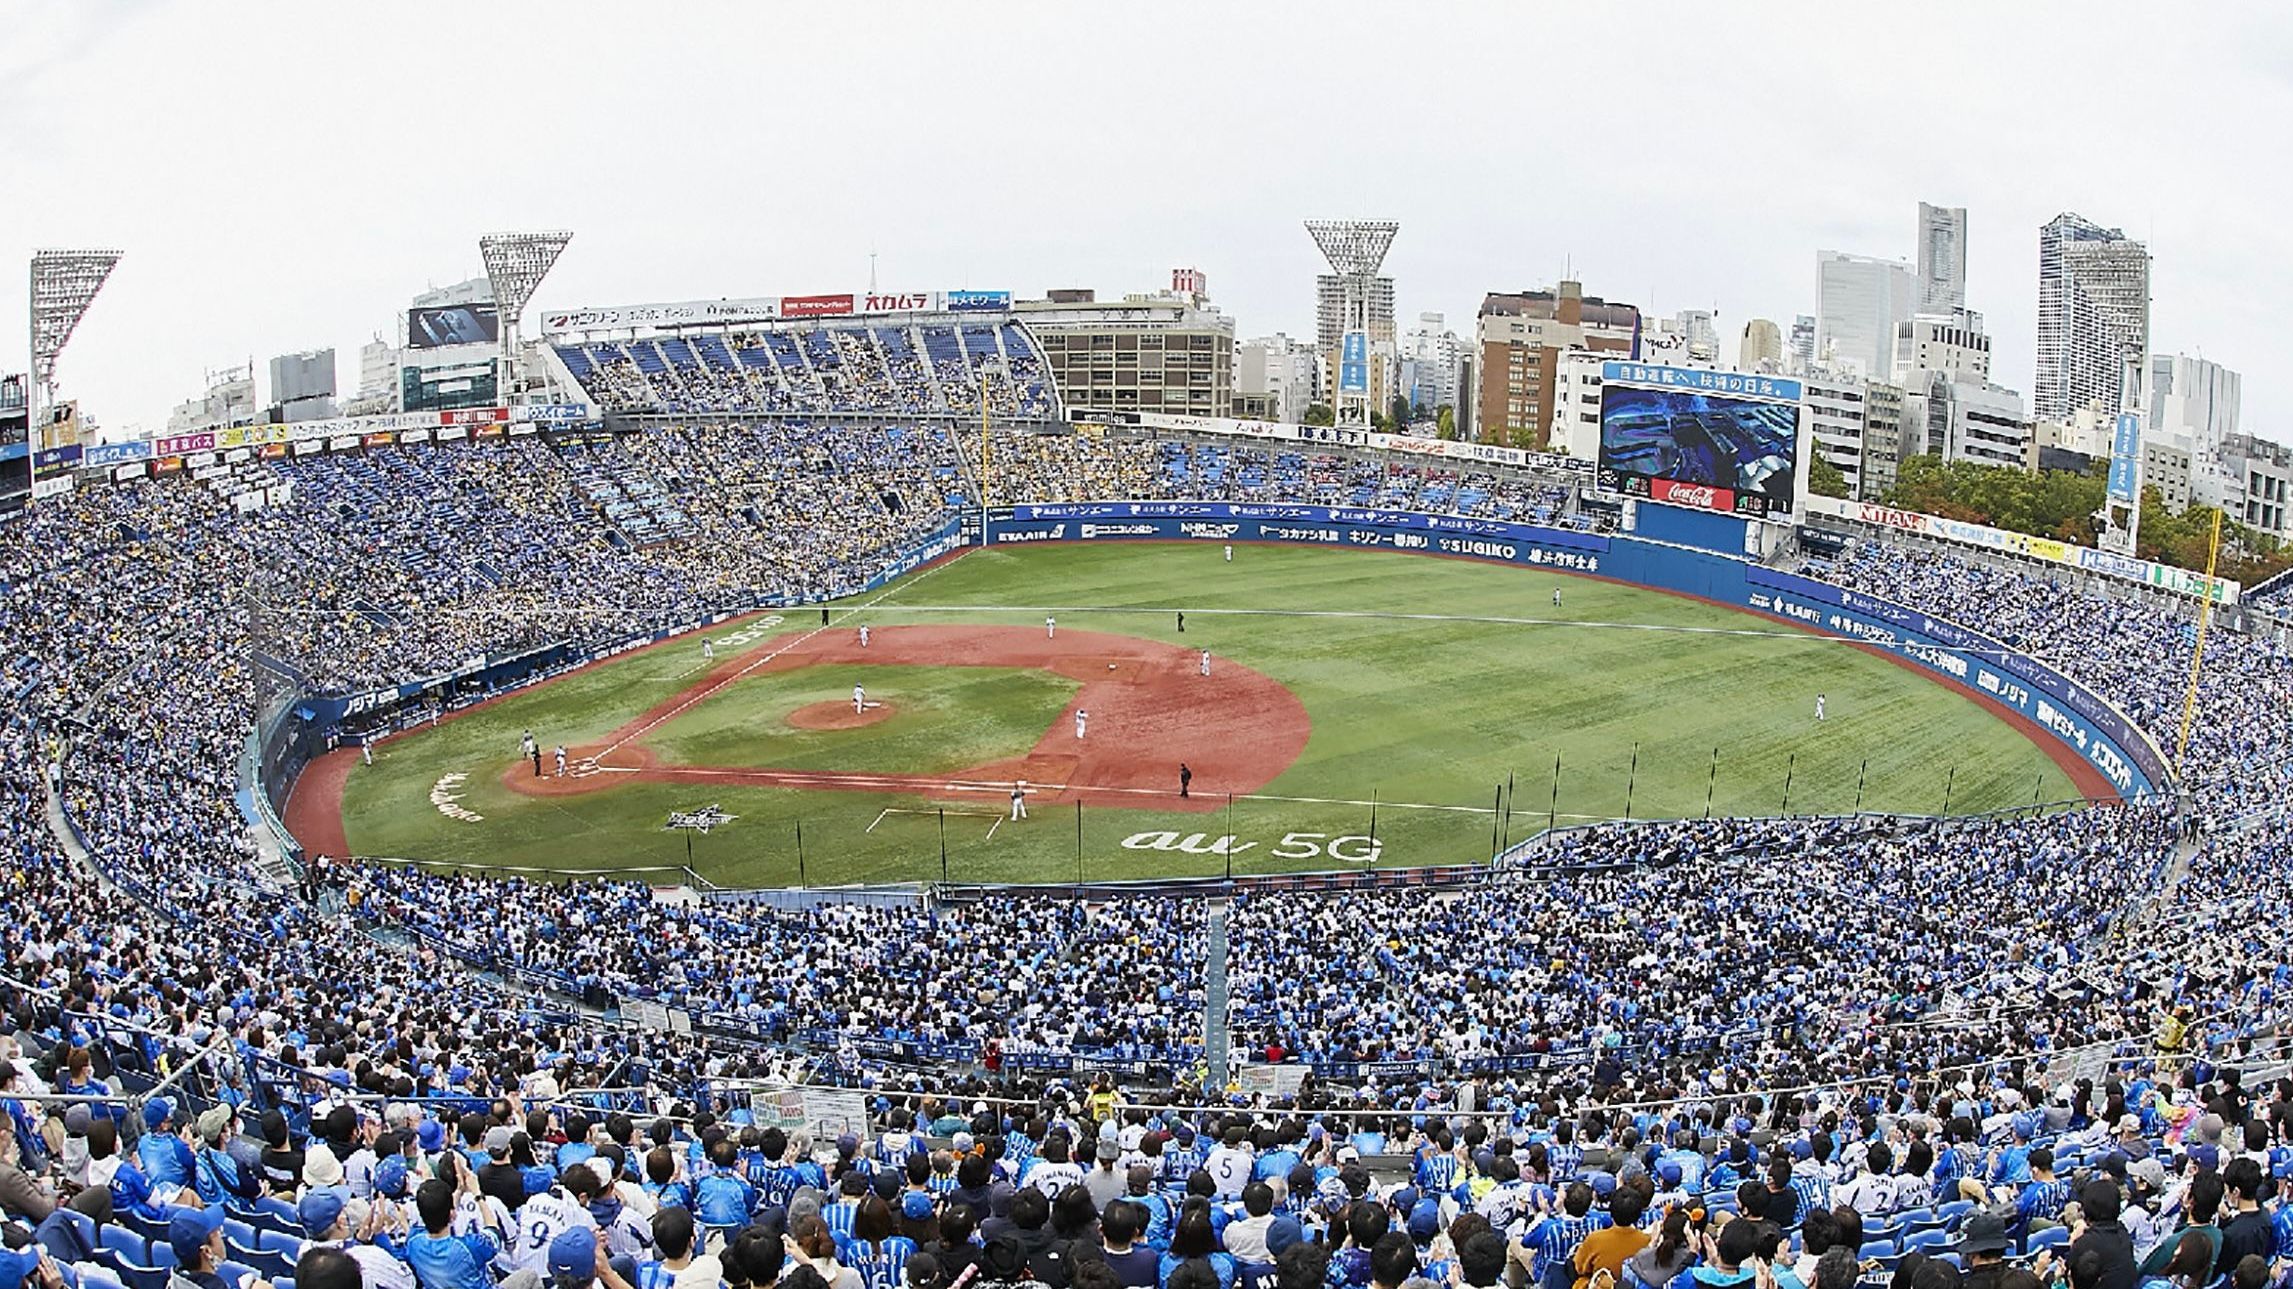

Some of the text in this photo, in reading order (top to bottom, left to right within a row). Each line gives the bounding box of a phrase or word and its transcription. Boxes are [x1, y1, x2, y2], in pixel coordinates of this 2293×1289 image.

[1450, 539, 1516, 559] SUGIKO
[1121, 831, 1383, 862] au 5G
[1219, 1157, 1232, 1179] 5
[529, 1221, 549, 1249] 9
